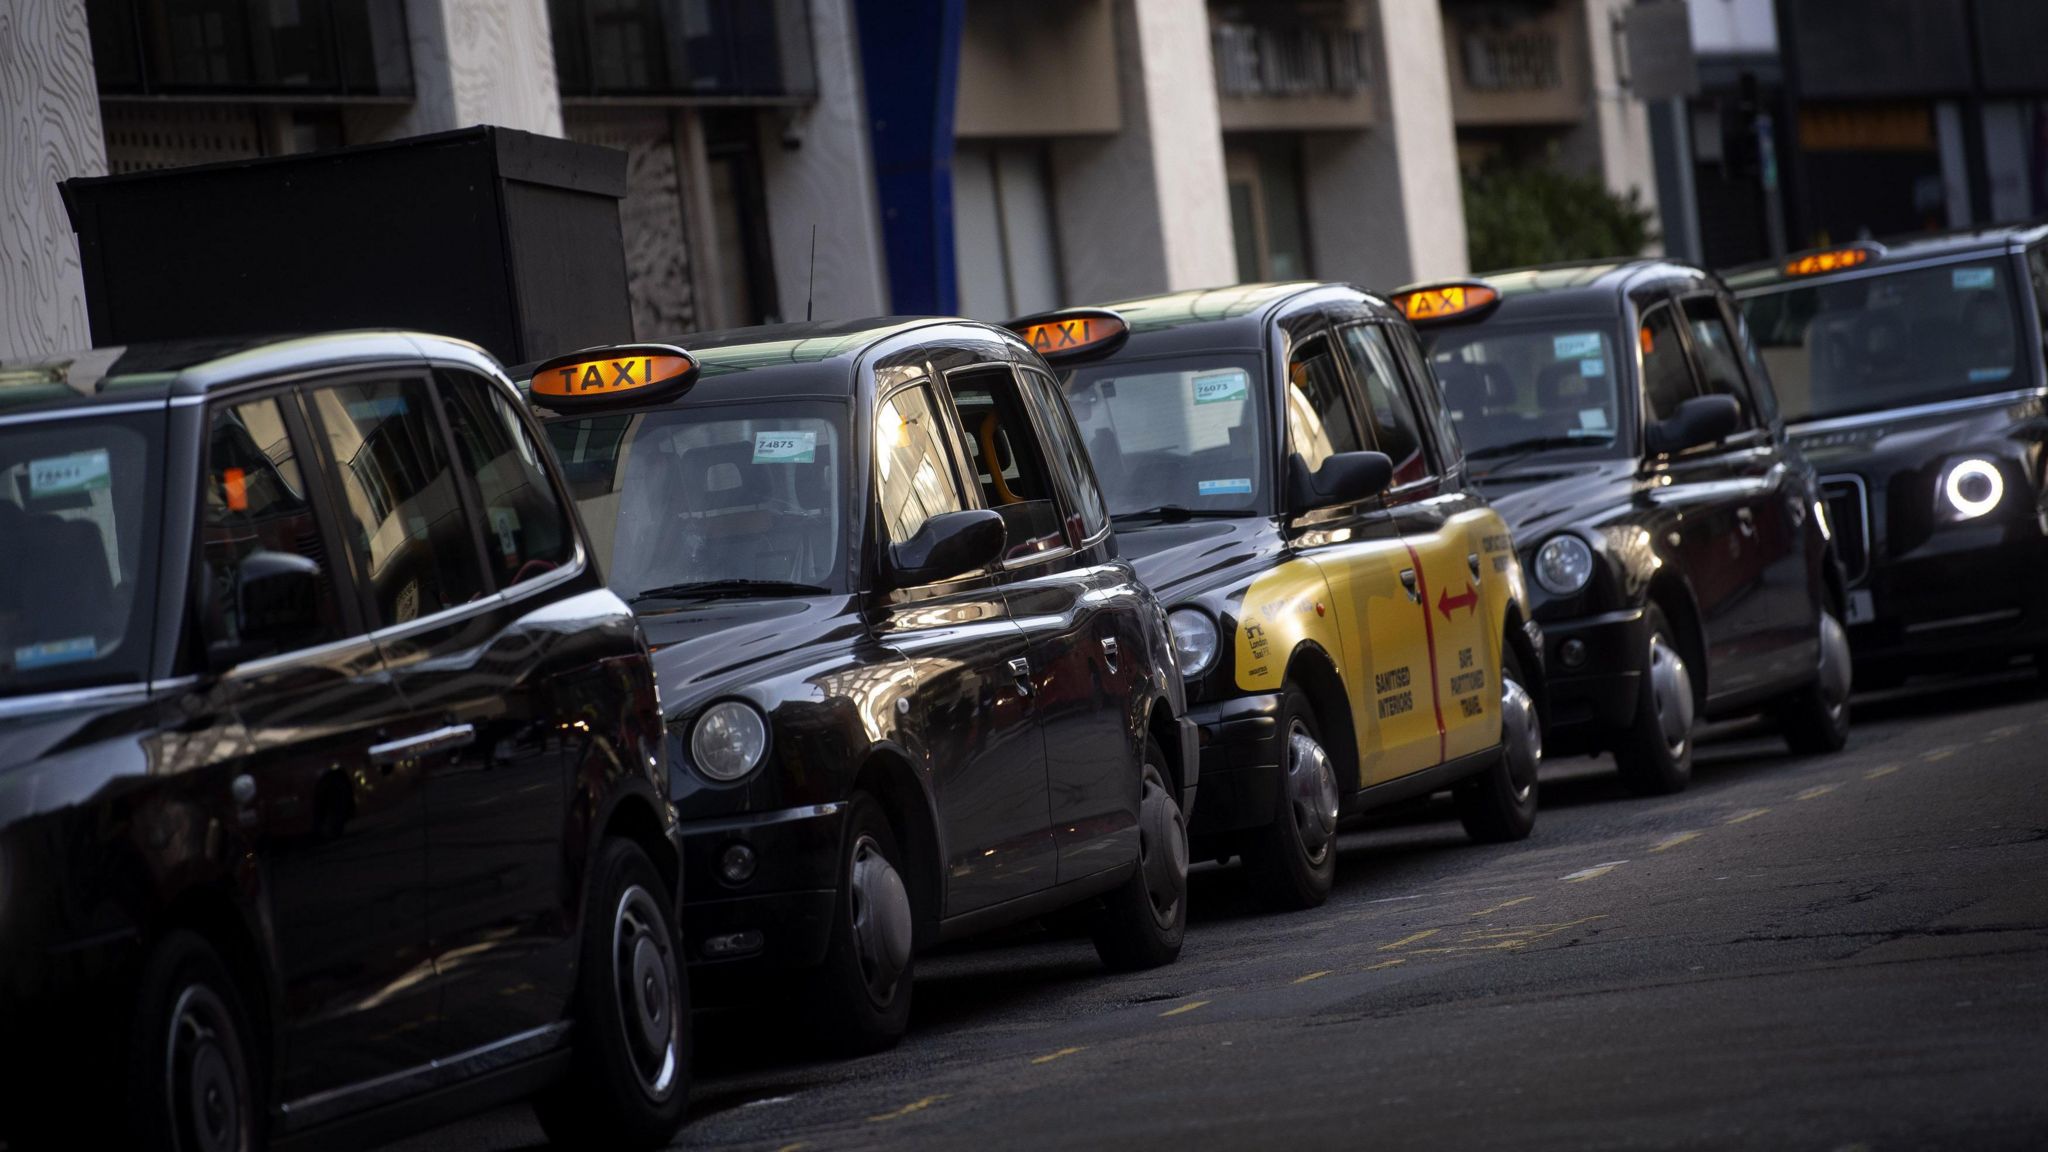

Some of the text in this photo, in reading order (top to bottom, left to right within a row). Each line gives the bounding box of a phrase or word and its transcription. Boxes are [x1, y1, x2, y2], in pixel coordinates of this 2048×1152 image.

[1022, 320, 1090, 349] AXI
[559, 358, 652, 393] TAXI
[758, 440, 794, 449] 74875
[1249, 638, 1268, 650] London
[1375, 666, 1411, 694] SANITISED
[1378, 690, 1413, 719] INTERIORS
